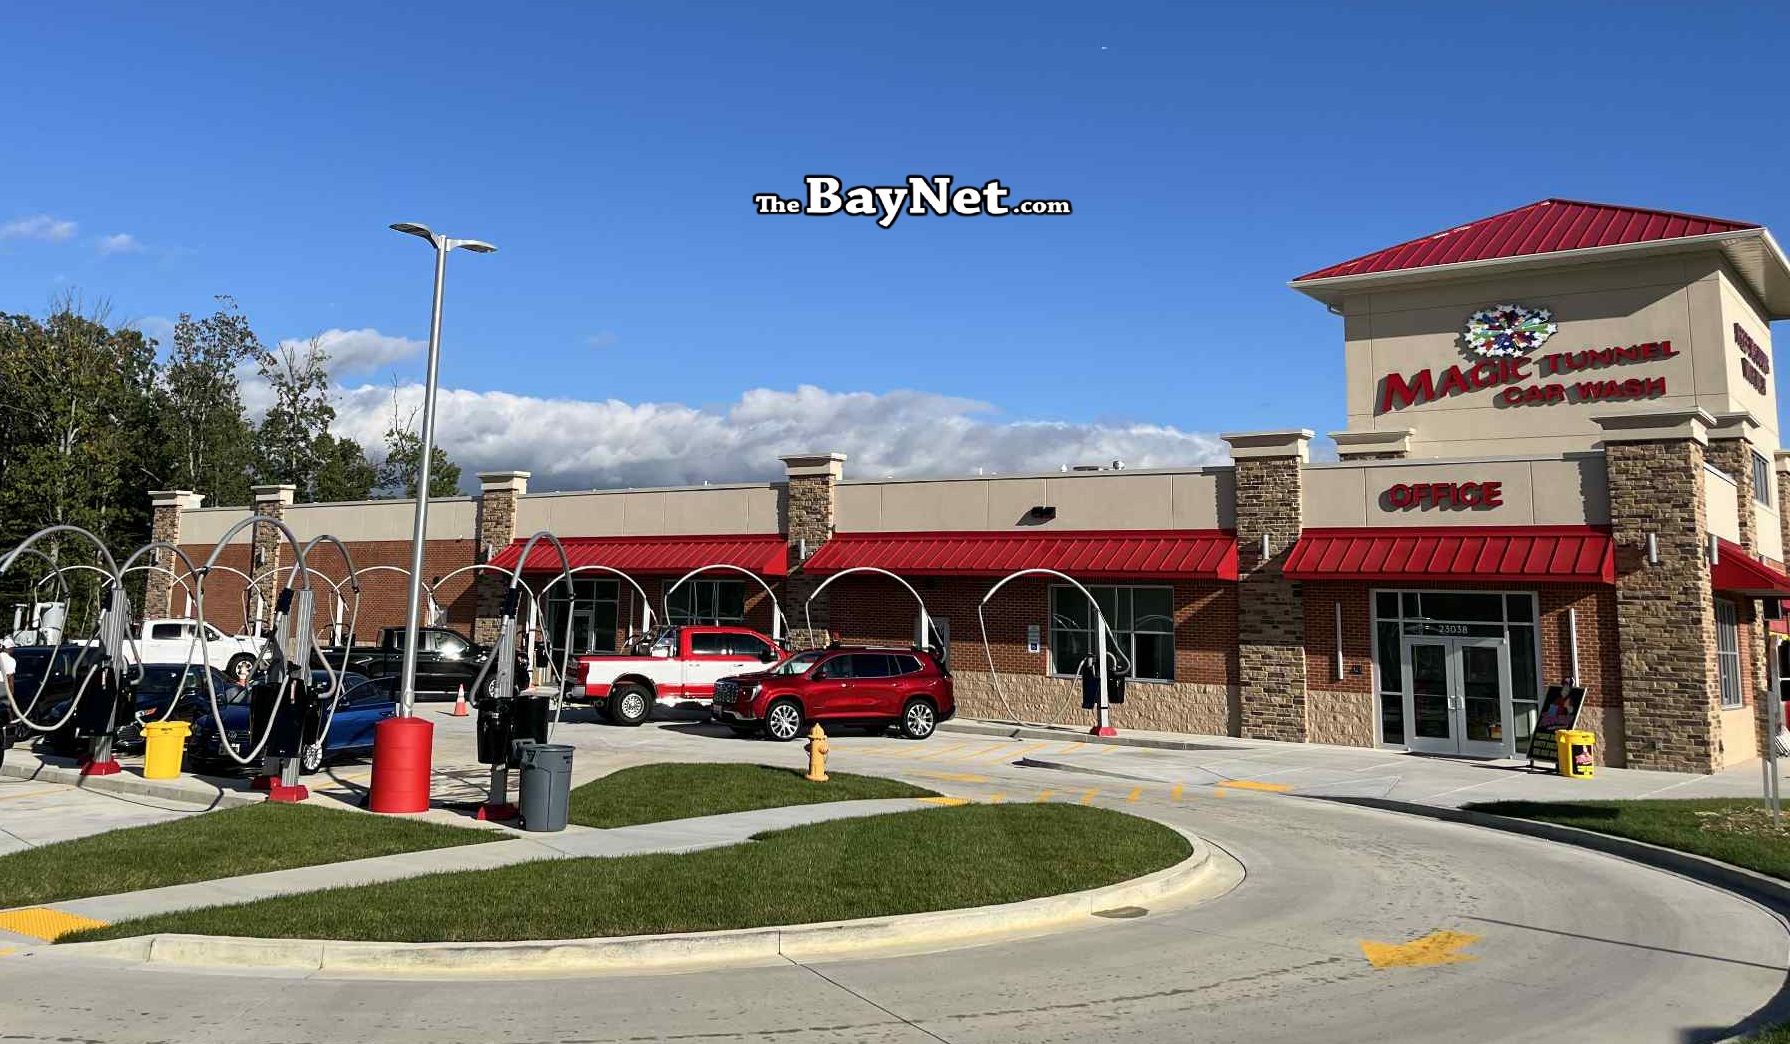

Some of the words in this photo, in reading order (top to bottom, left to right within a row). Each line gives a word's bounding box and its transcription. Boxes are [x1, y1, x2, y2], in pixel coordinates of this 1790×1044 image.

[1382, 357, 1533, 413] MAGIC
[1543, 341, 1679, 374] TUNNEL
[1502, 382, 1566, 405] CAR
[1576, 376, 1667, 400] WASH
[1389, 481, 1503, 508] OFFICE
[1438, 624, 1468, 634] 23038
